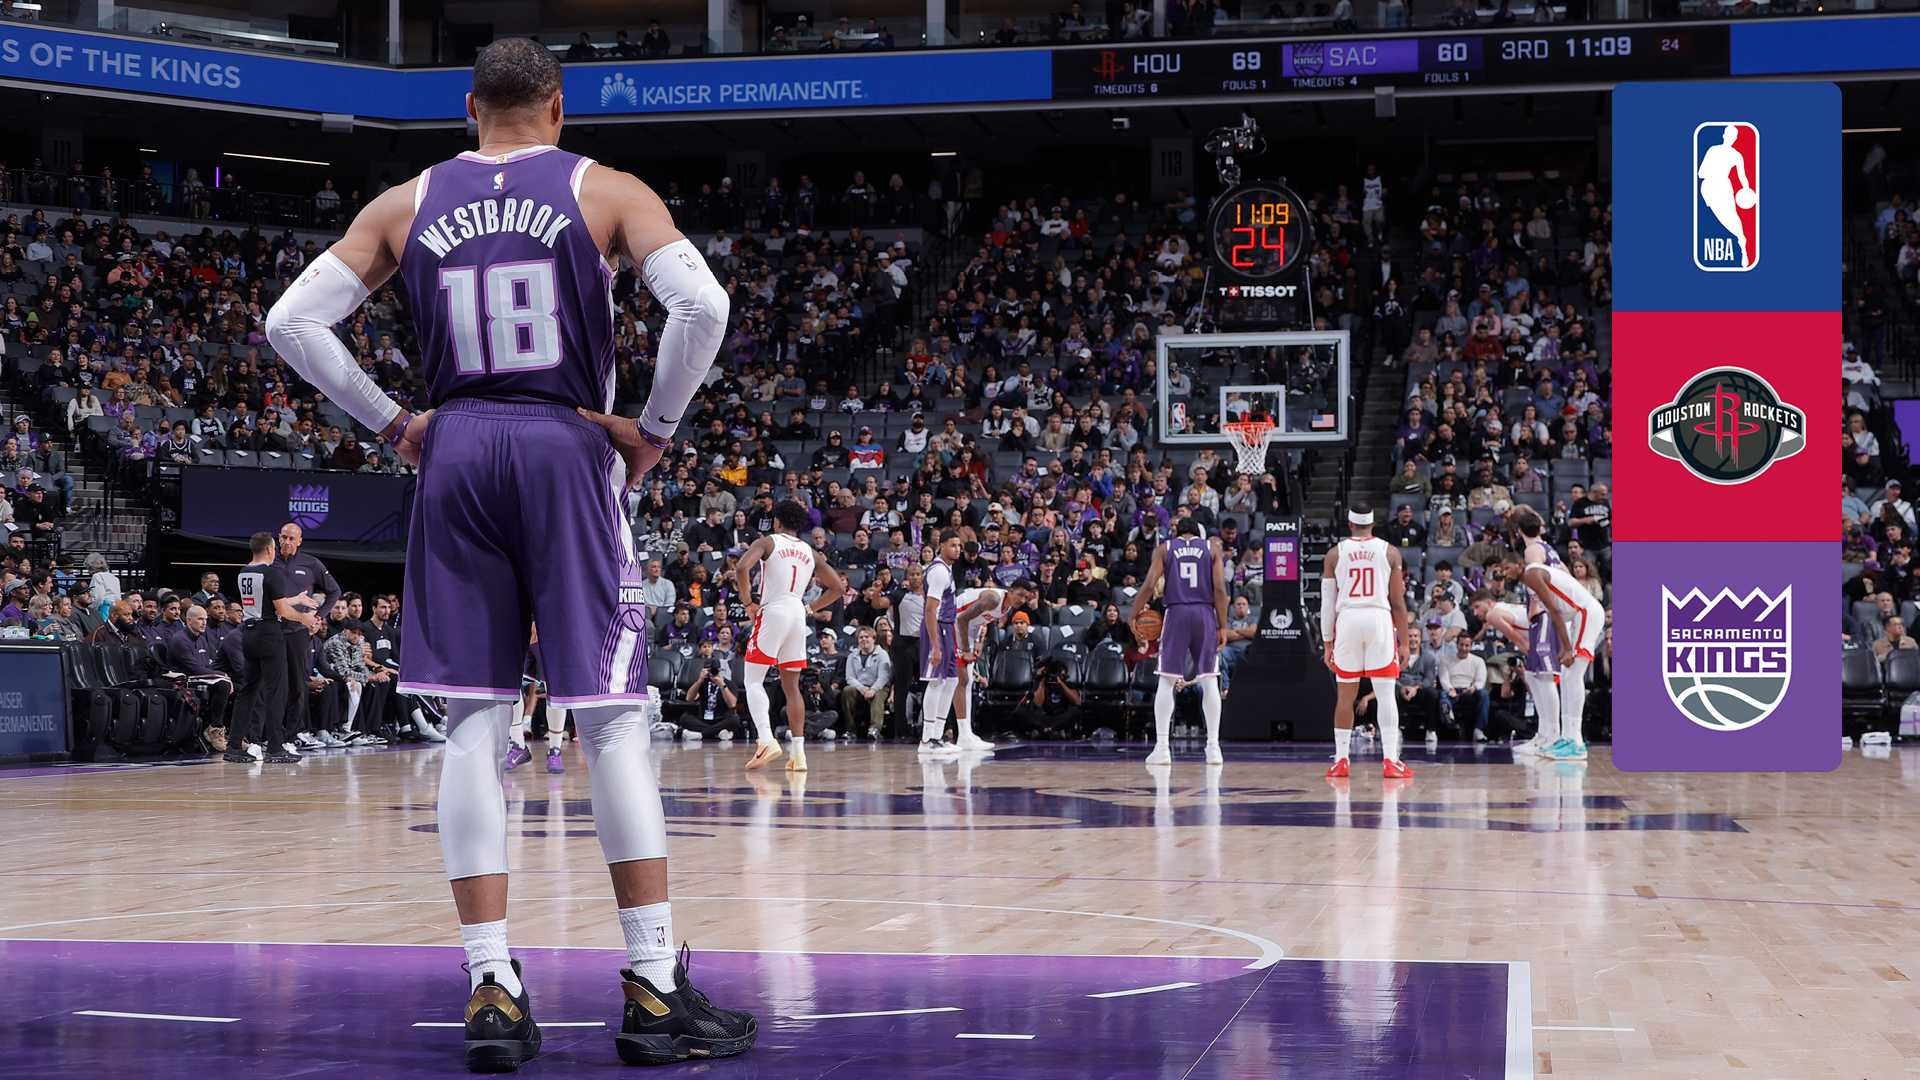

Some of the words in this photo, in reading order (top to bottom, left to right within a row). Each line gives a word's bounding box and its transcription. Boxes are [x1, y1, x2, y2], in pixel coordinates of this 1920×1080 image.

[1437, 43, 1468, 62] 60
[1502, 39, 1549, 60] 3RD
[1566, 36, 1632, 57] 11:09
[1661, 38, 1680, 51] 24
[1, 39, 20, 63] S
[30, 42, 73, 68] OF
[82, 48, 142, 77] THE
[151, 56, 241, 89] KINGS
[1133, 53, 1181, 74] HOU
[1232, 51, 1262, 71] 69
[1329, 46, 1377, 66] SAC
[1223, 80, 1257, 91] FOULS
[1293, 77, 1345, 88] TIMEOUTS
[1350, 76, 1358, 86] 4
[1424, 72, 1459, 83] FOULS
[642, 85, 711, 105] KAISER
[720, 80, 862, 102] PERMANENTE
[1093, 83, 1145, 95] TIMEOUTS
[1150, 83, 1158, 93] 6
[1236, 203, 1289, 225] 11:09
[417, 198, 572, 259] WESTBROOK
[1231, 226, 1284, 267] 24
[438, 258, 563, 376] 18
[288, 501, 329, 512] KINGS
[1266, 522, 1296, 531] PATH
[789, 565, 797, 593] 1
[1179, 561, 1198, 588] 9
[1348, 567, 1375, 597] 20
[241, 577, 253, 595] 58
